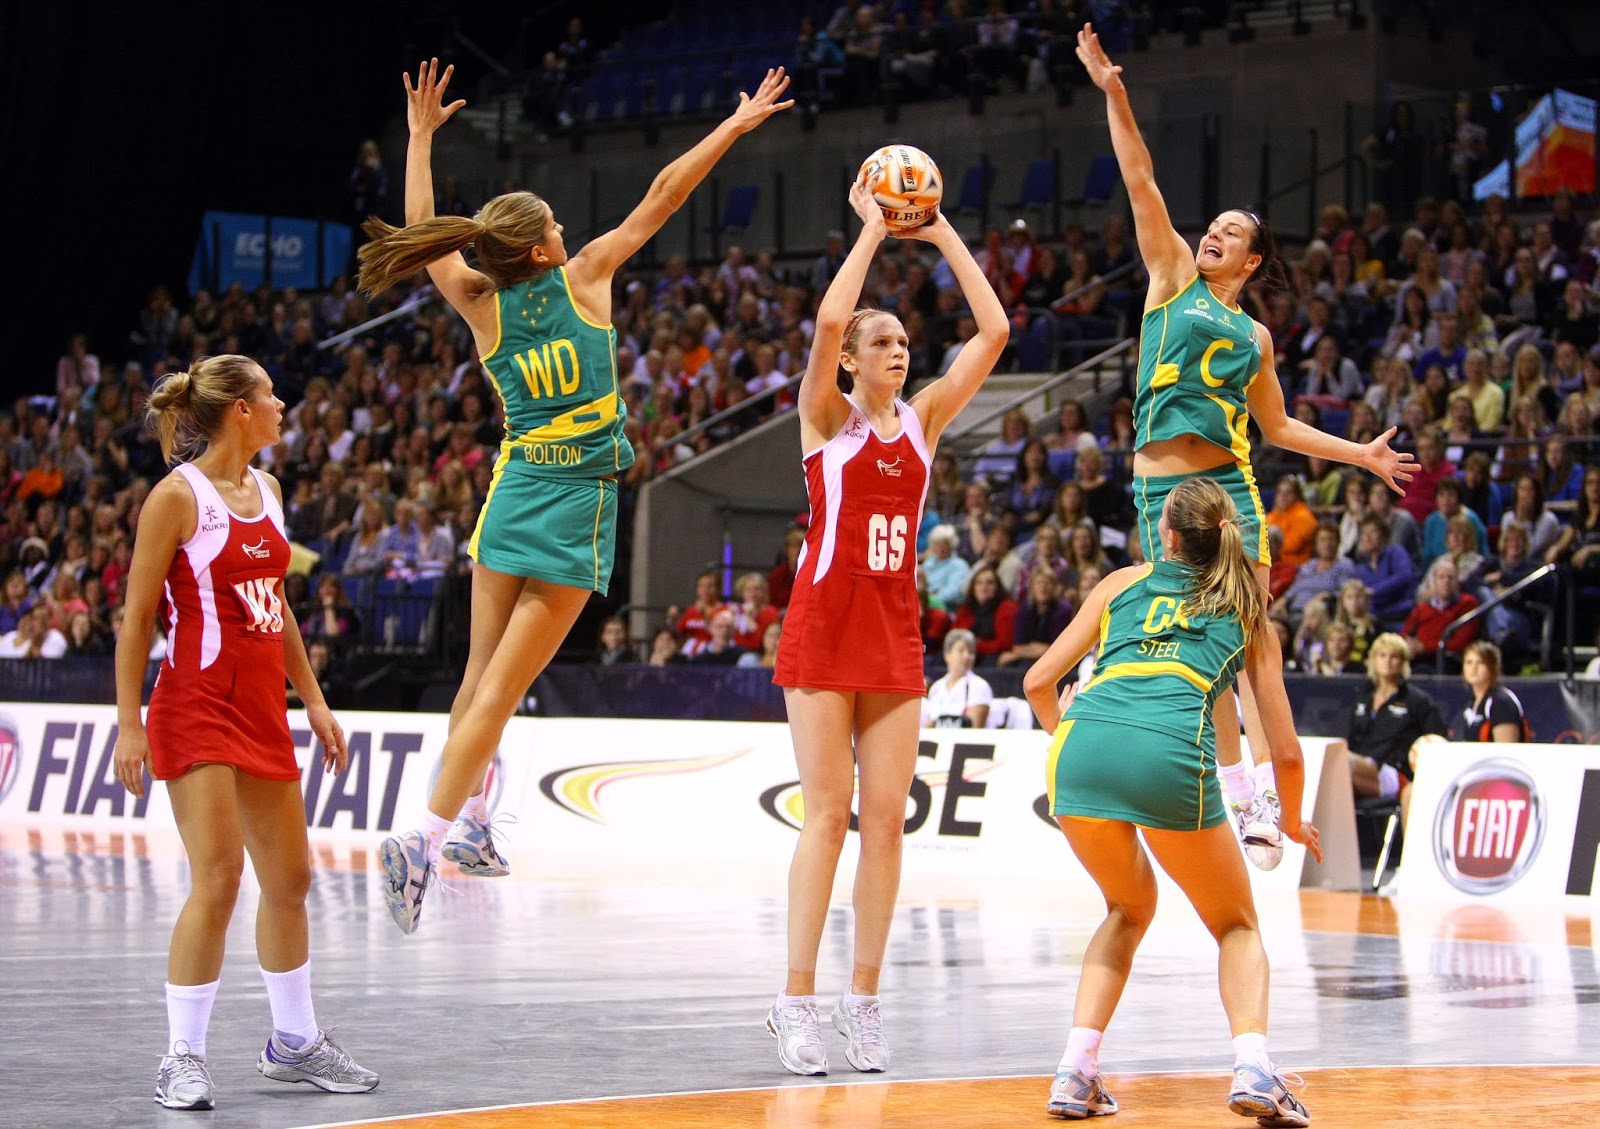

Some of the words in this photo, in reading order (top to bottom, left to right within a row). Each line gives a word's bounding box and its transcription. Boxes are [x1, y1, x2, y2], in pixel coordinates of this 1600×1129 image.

[881, 204, 936, 221] ILBER
[513, 338, 580, 399] WD
[1200, 338, 1235, 388] C
[524, 443, 581, 465] BOLTON
[201, 522, 228, 533] KUKRI
[867, 513, 908, 572] GS
[1136, 638, 1181, 659] STEEL
[1457, 798, 1527, 859] FIAT
